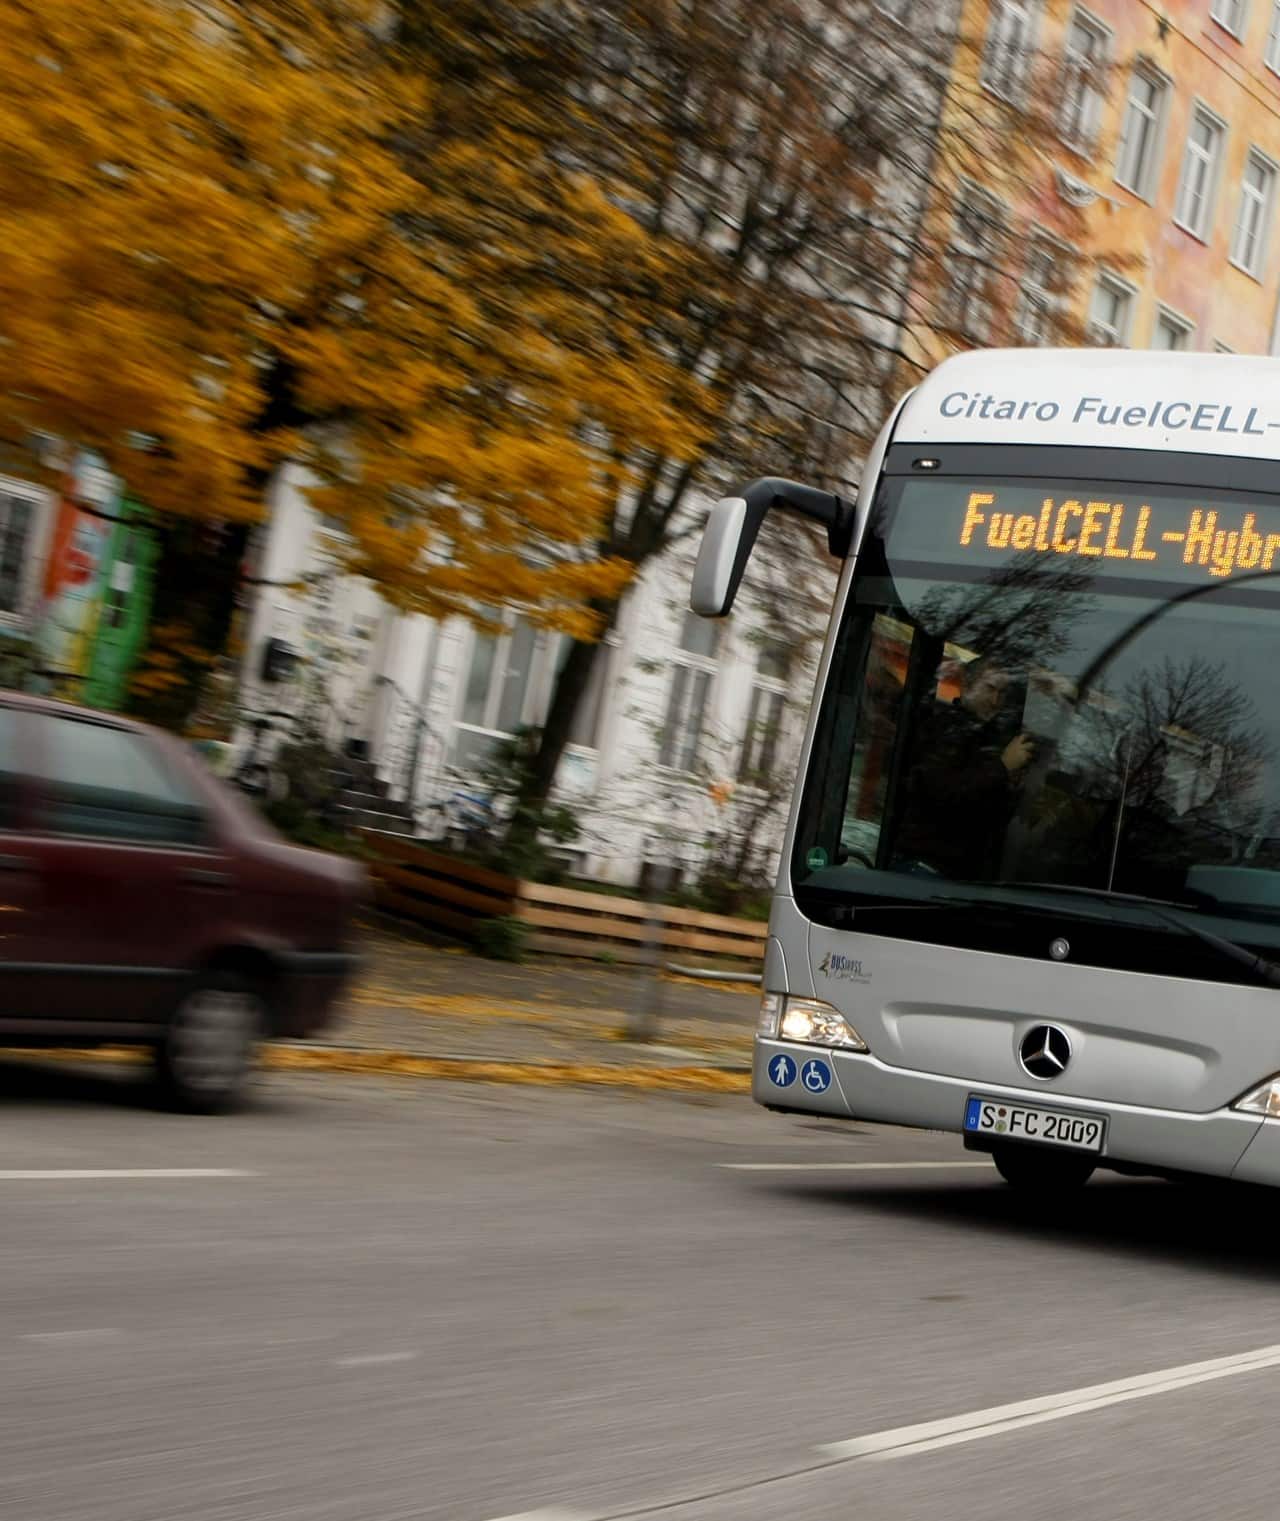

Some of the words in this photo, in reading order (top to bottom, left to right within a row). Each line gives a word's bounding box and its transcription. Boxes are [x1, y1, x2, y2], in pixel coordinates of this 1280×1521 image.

[939, 391, 1060, 422] Citaro
[981, 1105, 996, 1129] S
[1009, 1110, 1038, 1136] FC
[1042, 1116, 1099, 1146] 2009
